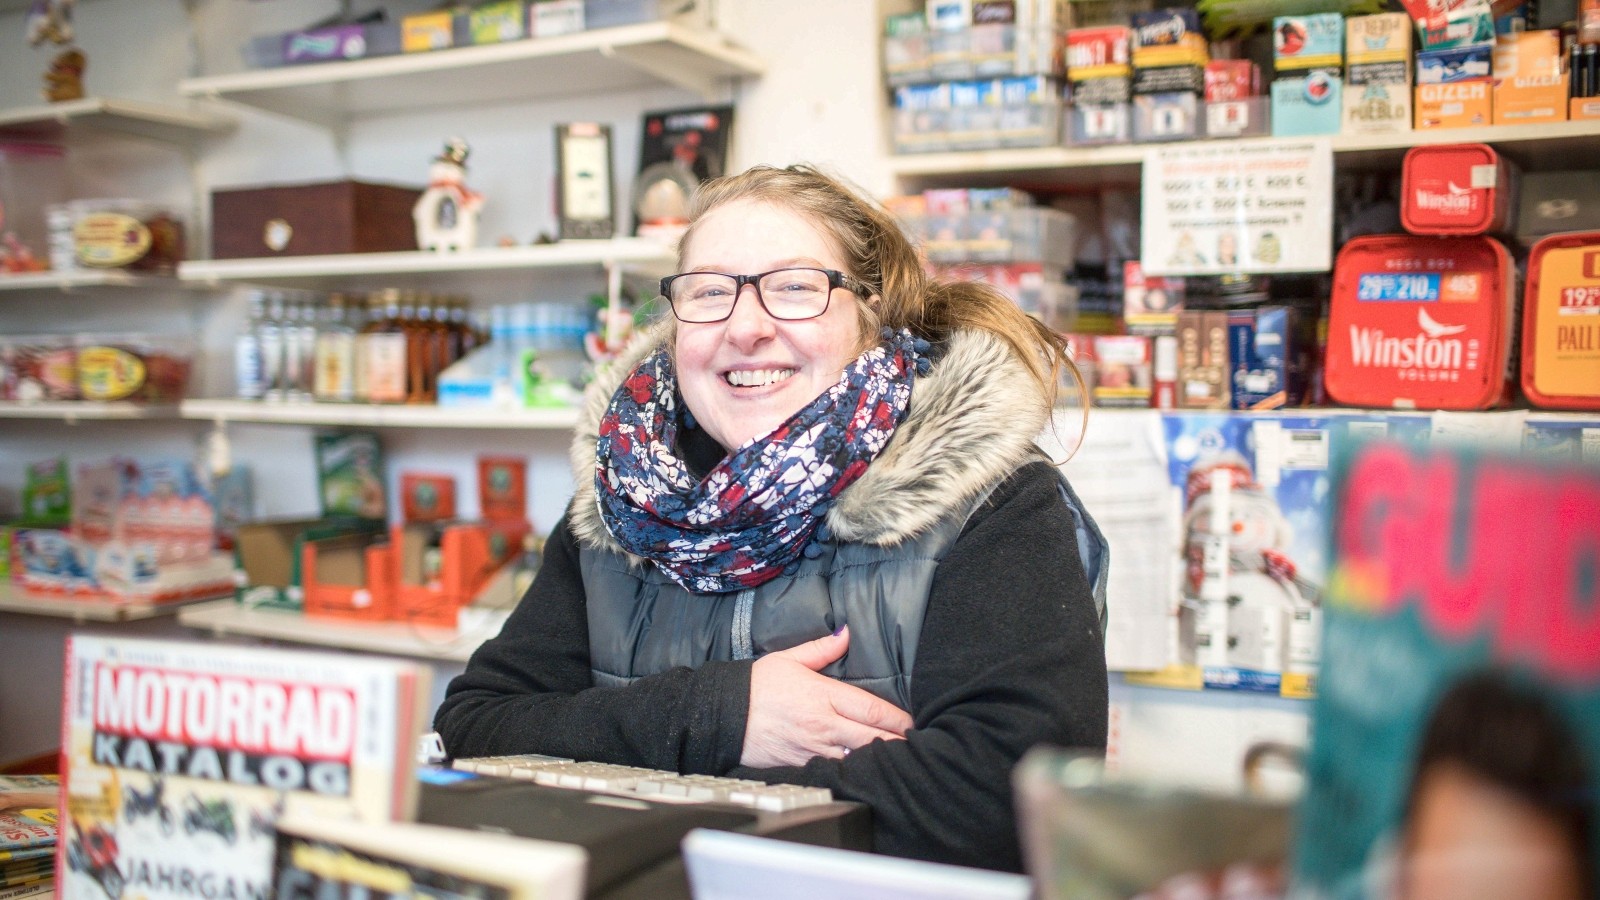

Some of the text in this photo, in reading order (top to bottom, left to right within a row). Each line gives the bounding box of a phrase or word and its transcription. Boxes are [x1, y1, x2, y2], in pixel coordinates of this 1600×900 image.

[1350, 101, 1405, 121] PUEBLO
[1416, 188, 1470, 211] Winston
[1358, 274, 1381, 300] 29
[1565, 287, 1588, 306] 19
[1350, 324, 1462, 369] Winston
[1557, 325, 1594, 351] PALL
[1466, 338, 1480, 369] RED
[1398, 370, 1460, 382] VOLUME
[96, 667, 354, 760] MOTORRAD
[95, 734, 348, 797] KATALOG
